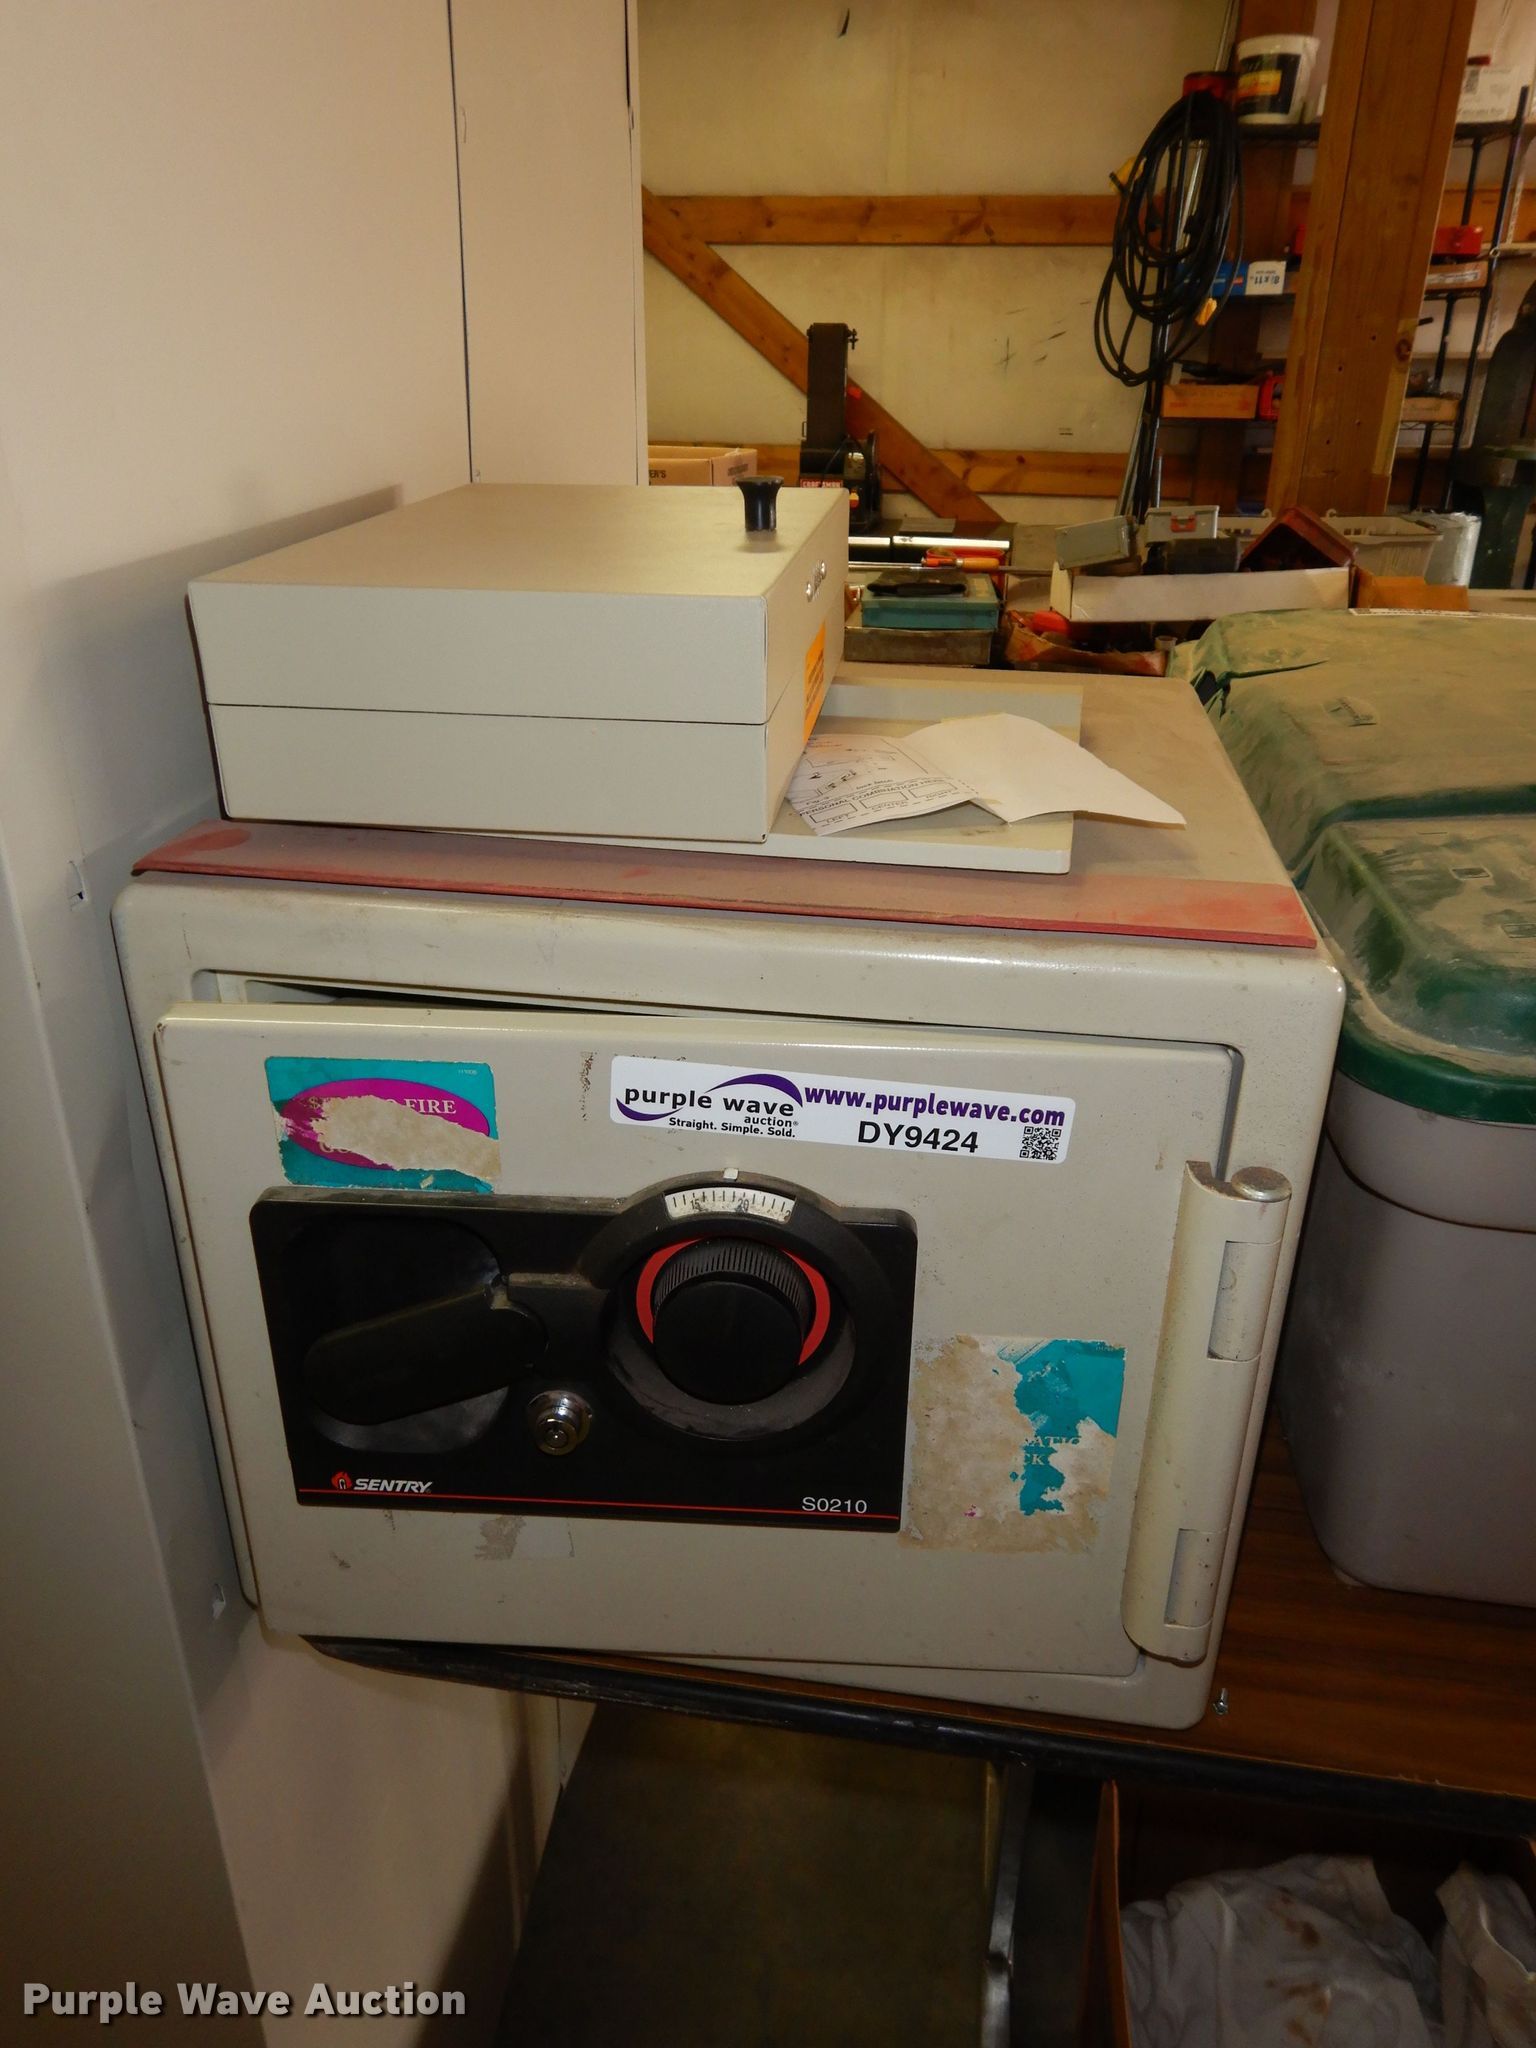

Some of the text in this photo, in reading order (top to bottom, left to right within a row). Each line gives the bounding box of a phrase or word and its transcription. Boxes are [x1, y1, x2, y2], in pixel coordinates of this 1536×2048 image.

[800, 799, 848, 816] PERSONAL
[852, 782, 919, 800] COMBINATION
[404, 1098, 456, 1114] FIRE
[625, 1088, 794, 1117] purple wave
[804, 1087, 1065, 1126] www.purplewave.com
[669, 1117, 796, 1138] Straight. Simple. Sold.
[857, 1121, 979, 1153] DY9424
[737, 1198, 749, 1213] 20
[353, 1478, 433, 1493] SENTRY
[802, 1496, 867, 1514] S0210
